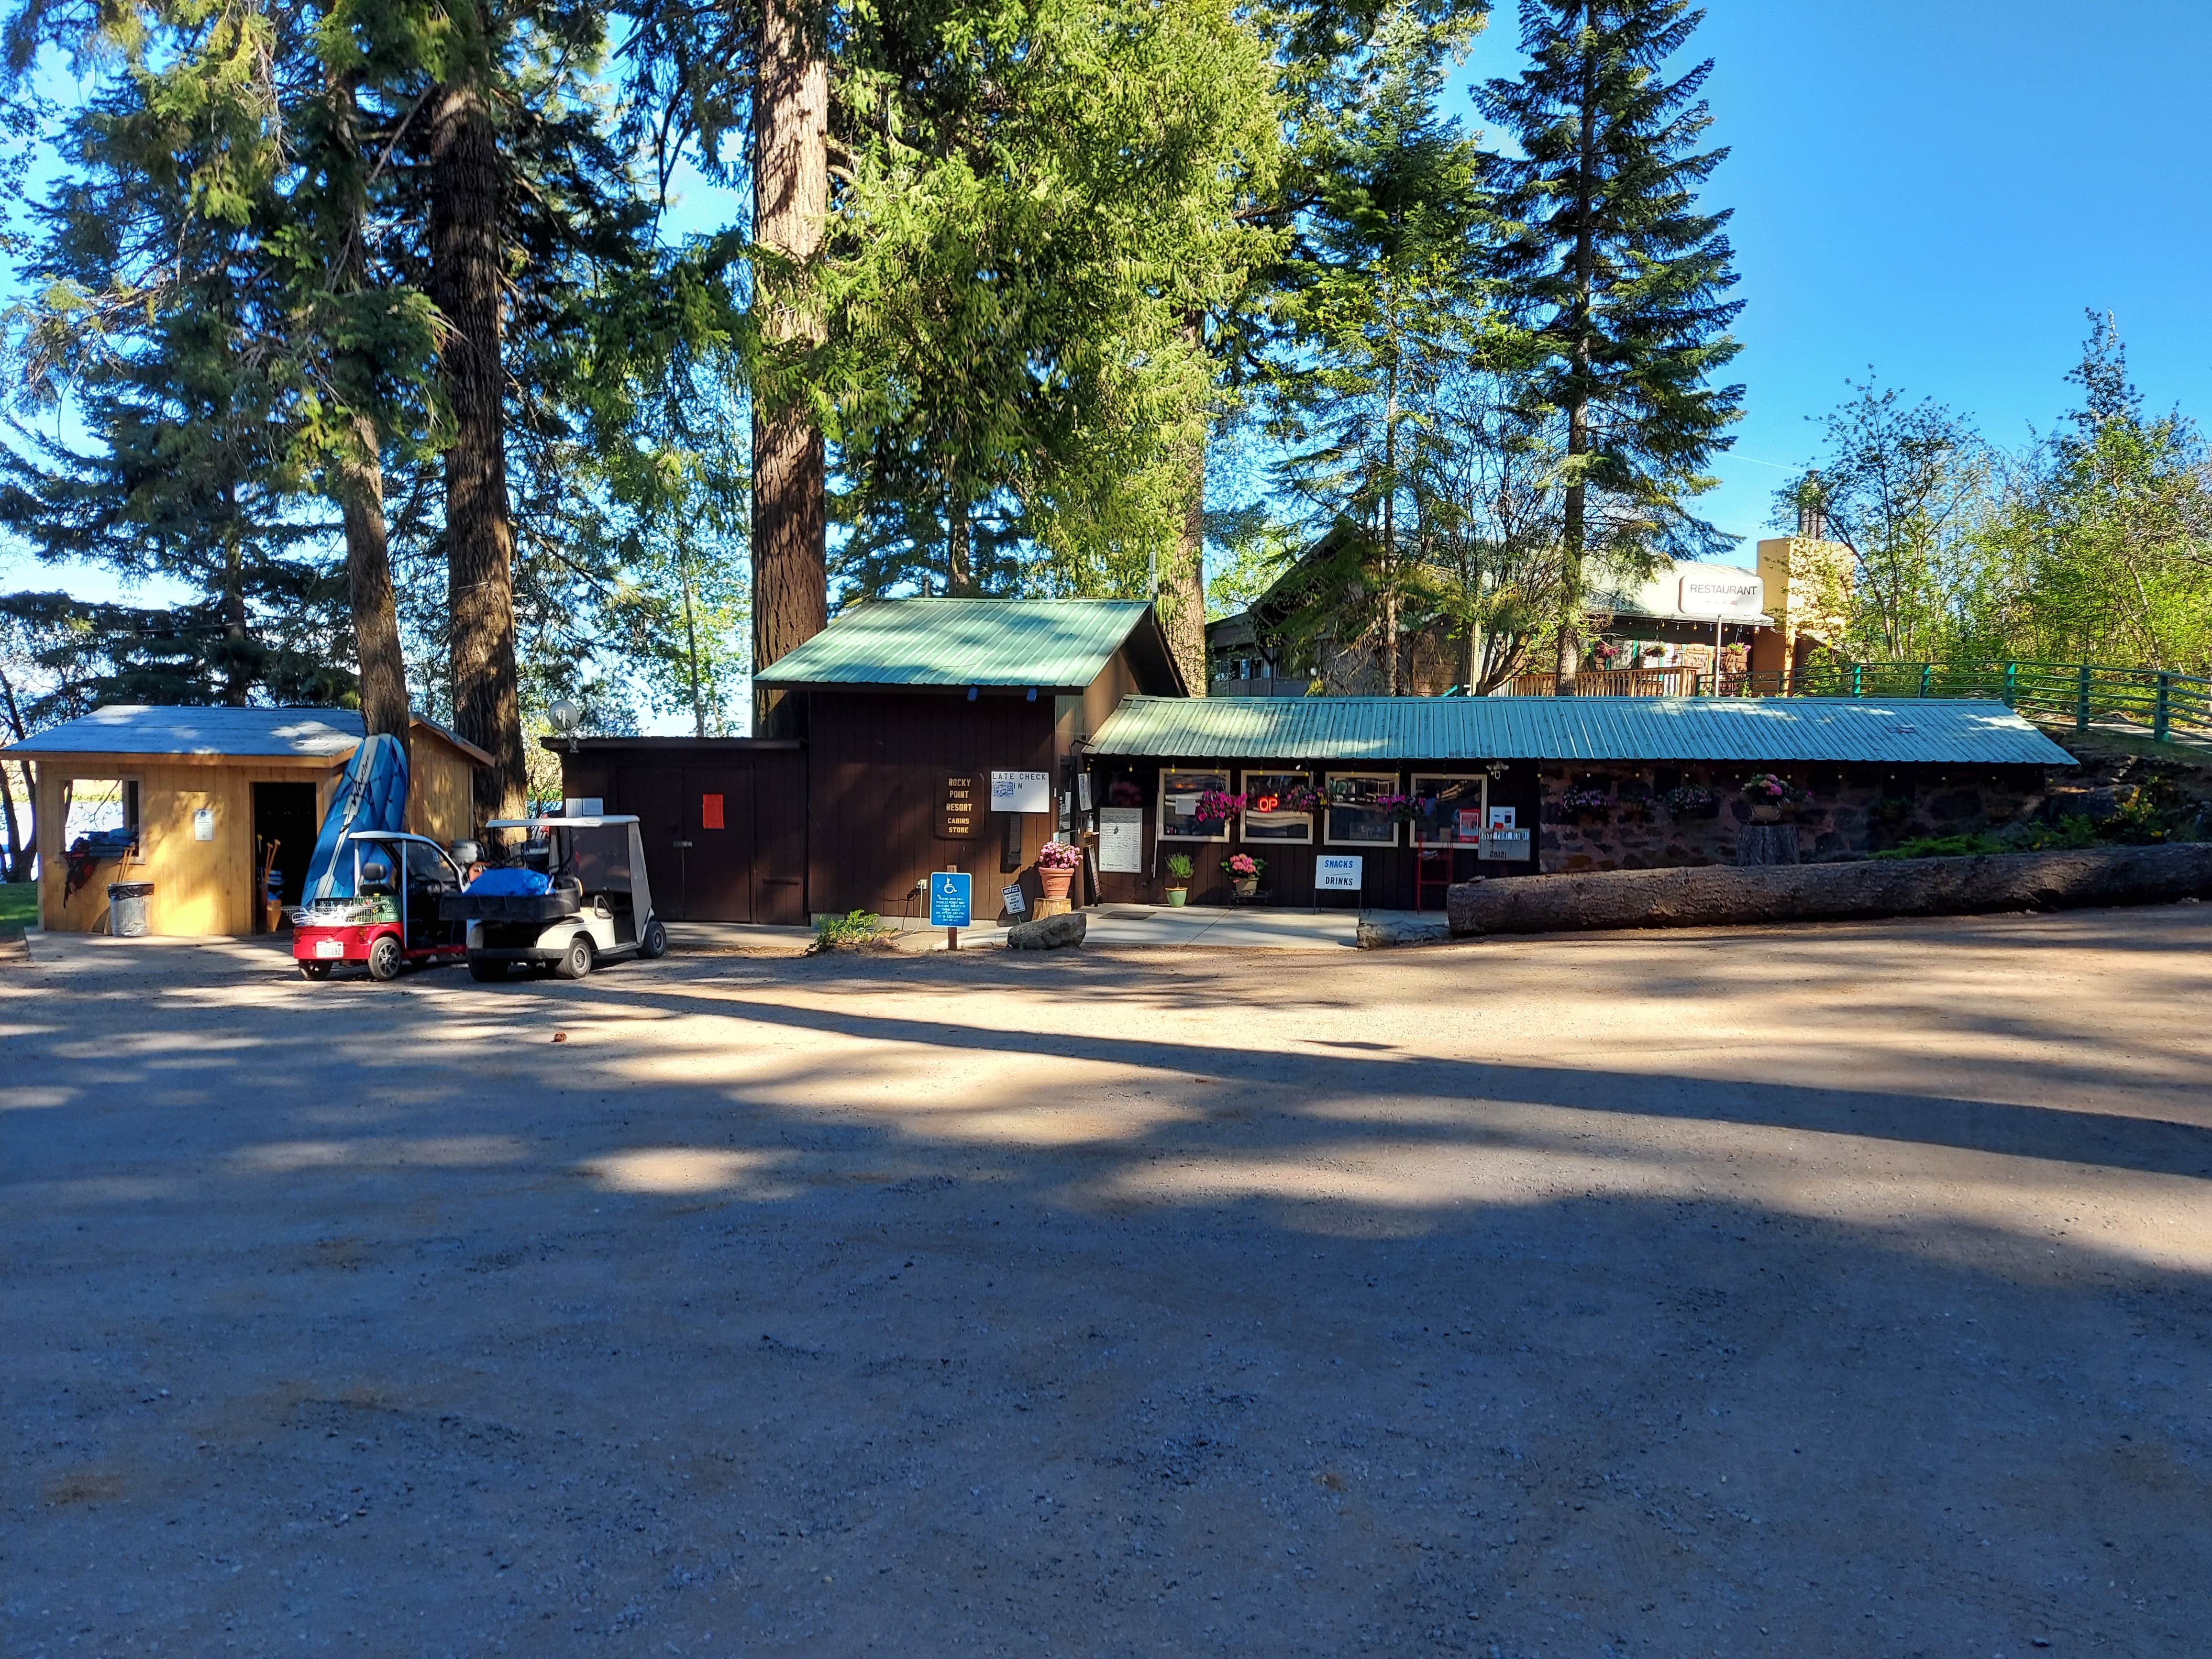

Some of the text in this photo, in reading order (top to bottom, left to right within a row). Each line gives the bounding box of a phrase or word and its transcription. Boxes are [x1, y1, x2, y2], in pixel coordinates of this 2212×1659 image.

[1690, 584, 1757, 595] RESTAURANT
[948, 778, 971, 787] ROCKY
[949, 790, 969, 798] POINT
[946, 803, 973, 812] RESORT
[1496, 831, 1509, 840] POINT
[1324, 860, 1353, 869] SNACKS
[1325, 876, 1353, 886] DRINKS
